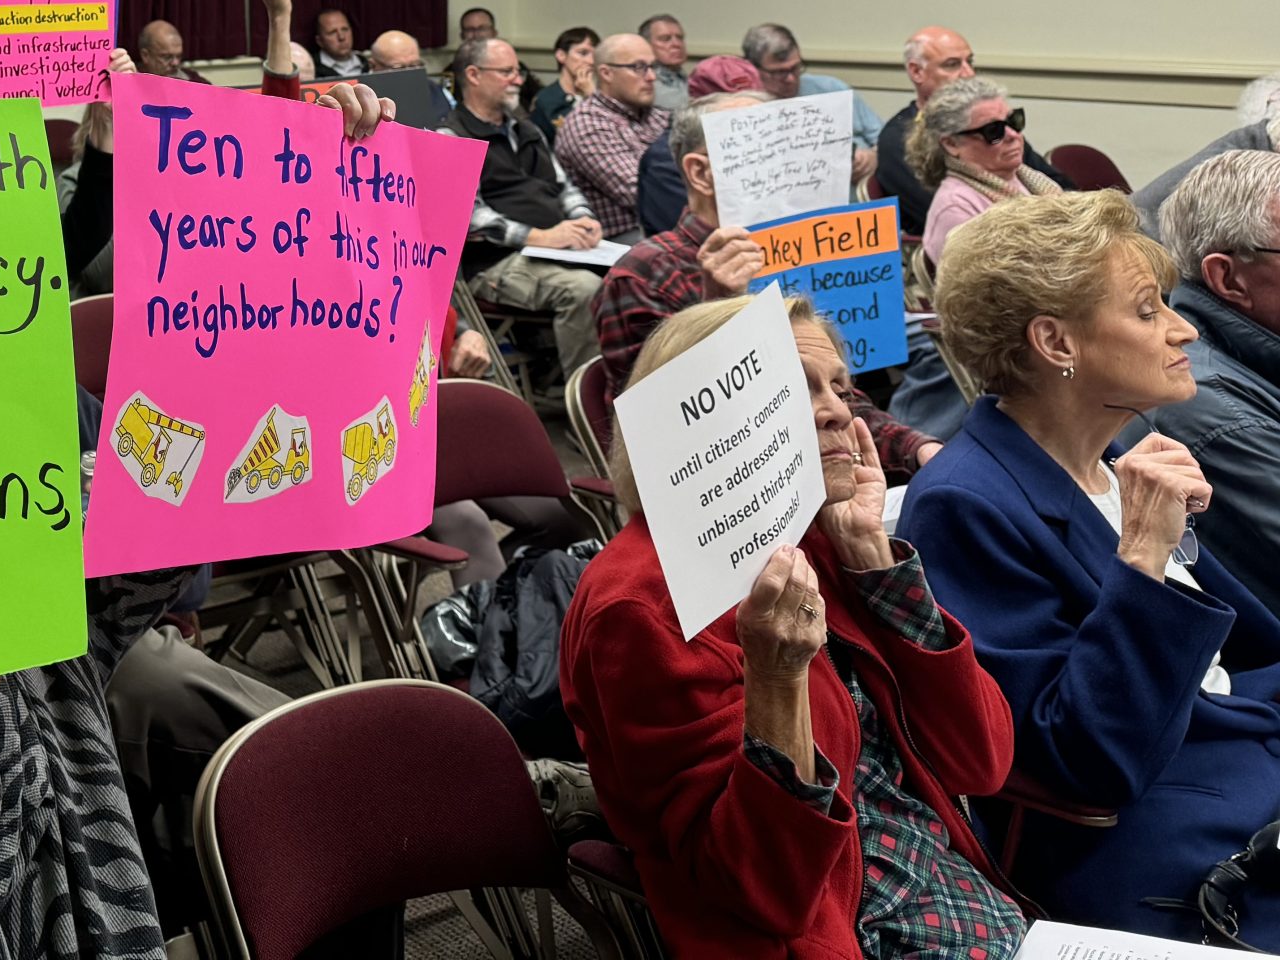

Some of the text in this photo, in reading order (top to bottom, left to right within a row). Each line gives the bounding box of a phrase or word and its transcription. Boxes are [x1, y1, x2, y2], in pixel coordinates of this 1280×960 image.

[0, 54, 96, 85] investigated
[17, 35, 112, 54] infrastructure
[55, 69, 111, 100] voted?
[141, 104, 244, 179] Ten
[274, 128, 312, 184] to
[148, 207, 447, 283] years of this in our
[813, 213, 879, 257] Field
[811, 264, 894, 290] because
[679, 348, 763, 427] NO VOTE
[669, 384, 792, 487] until citizens' concerns
[699, 426, 790, 509] are addressed by
[697, 450, 804, 548] unbiased third-party
[729, 490, 801, 569] professionals!
